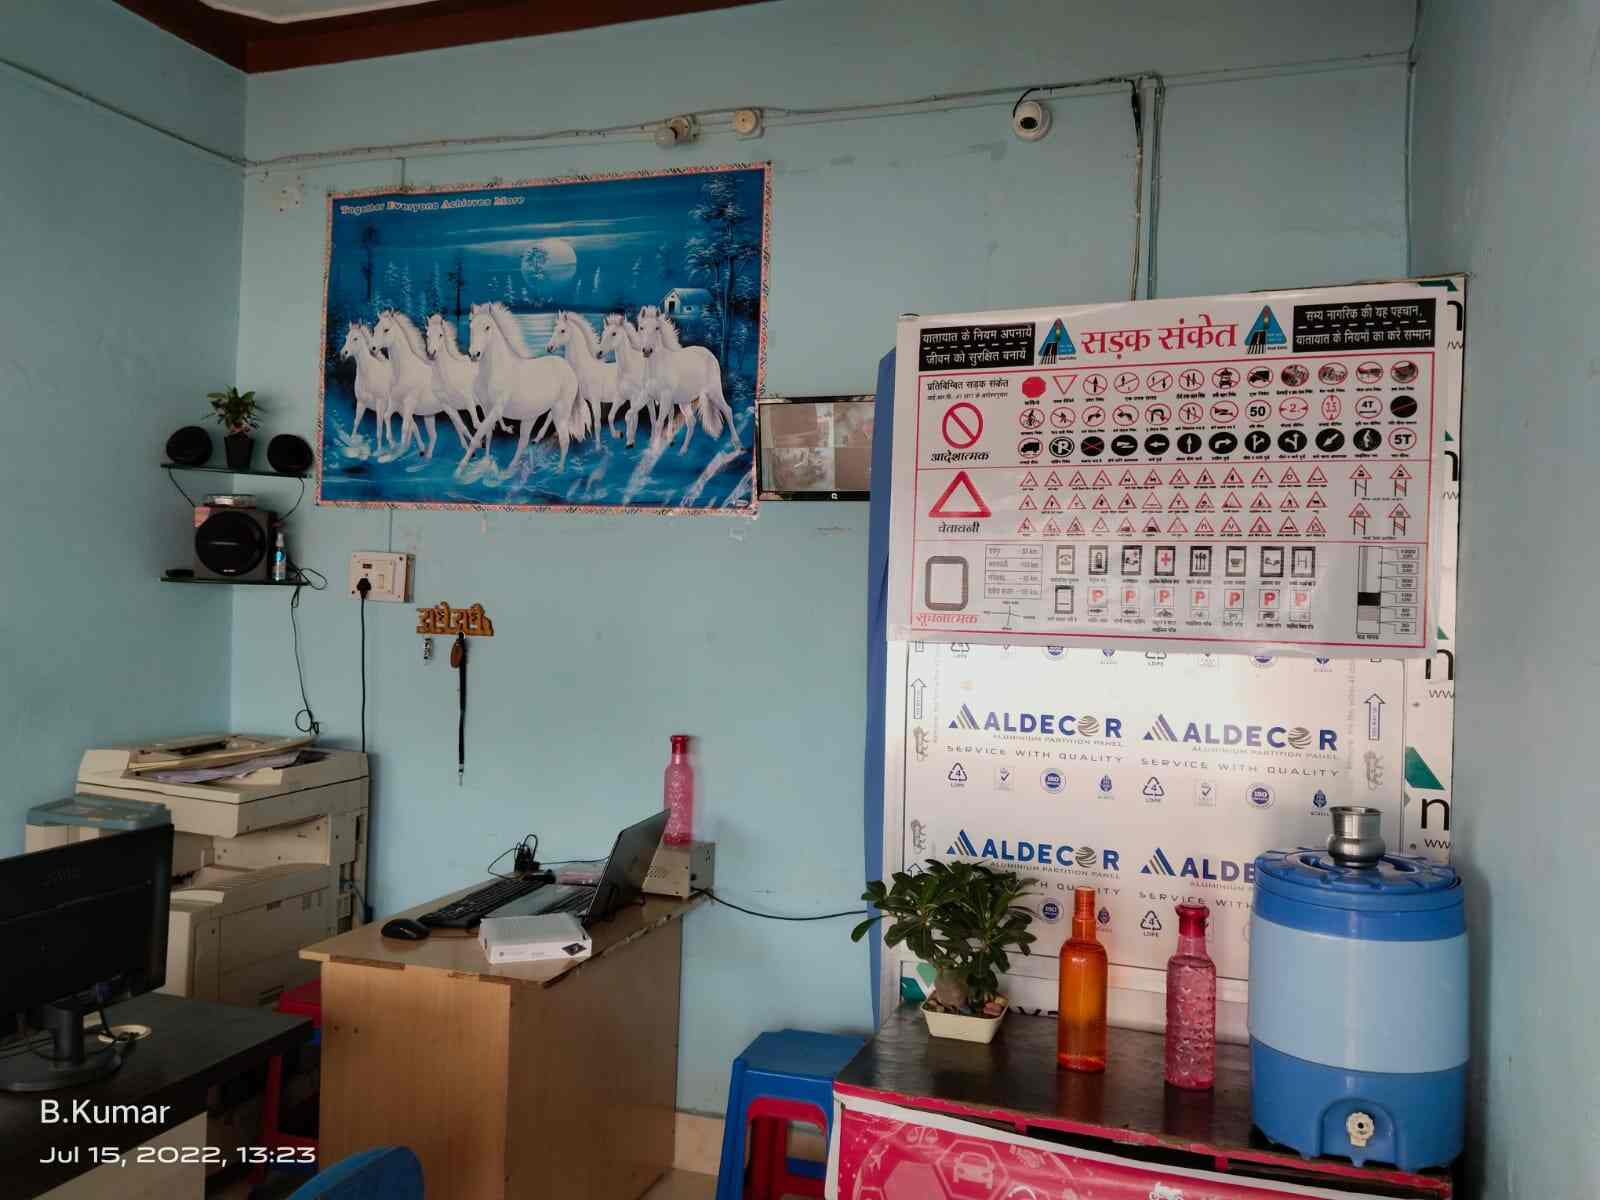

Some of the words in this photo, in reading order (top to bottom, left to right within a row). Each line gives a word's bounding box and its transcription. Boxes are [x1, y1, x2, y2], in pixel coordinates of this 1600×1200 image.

[1326, 305, 1359, 320] नागरिक
[1361, 303, 1373, 319] की
[1375, 307, 1389, 319] यह
[922, 332, 958, 344] यातायात
[962, 329, 971, 342] के
[973, 327, 997, 341] नियम
[1080, 328, 1153, 360] सड़क
[1158, 313, 1239, 351] संकेत
[1296, 334, 1330, 346] यातायात
[1333, 331, 1343, 344] के
[1372, 330, 1385, 342] का
[1403, 328, 1432, 342] सम्मान
[926, 351, 950, 366] जीवन
[953, 350, 965, 364] को
[968, 348, 999, 367] सुरक्षित
[1250, 406, 1266, 417] 50
[1361, 400, 1375, 409] 4T
[1394, 434, 1412, 445] 5T
[930, 449, 990, 464] आदेशात्मक
[938, 521, 981, 535] चेतावनी
[1091, 590, 1104, 602] P
[1125, 591, 1137, 602] P
[1159, 590, 1170, 602] P
[1194, 591, 1206, 603] P
[1228, 592, 1241, 606] P
[1264, 592, 1277, 605] P
[1295, 592, 1307, 605] P
[915, 612, 977, 628] सूचनात्मक
[984, 711, 1122, 739] ALDECOR
[1183, 722, 1337, 752] ALDECOR
[946, 744, 1006, 756] SERVICE
[1016, 750, 1051, 760] WITH
[1059, 752, 1123, 763] QUALITY
[1141, 757, 1208, 769] SERVICE
[1218, 763, 1257, 773] WITH
[1267, 765, 1339, 777] QUALITY
[982, 838, 1121, 871] ALDECOR
[1057, 882, 1121, 896] QUITY
[1138, 891, 1208, 905] SERVICE
